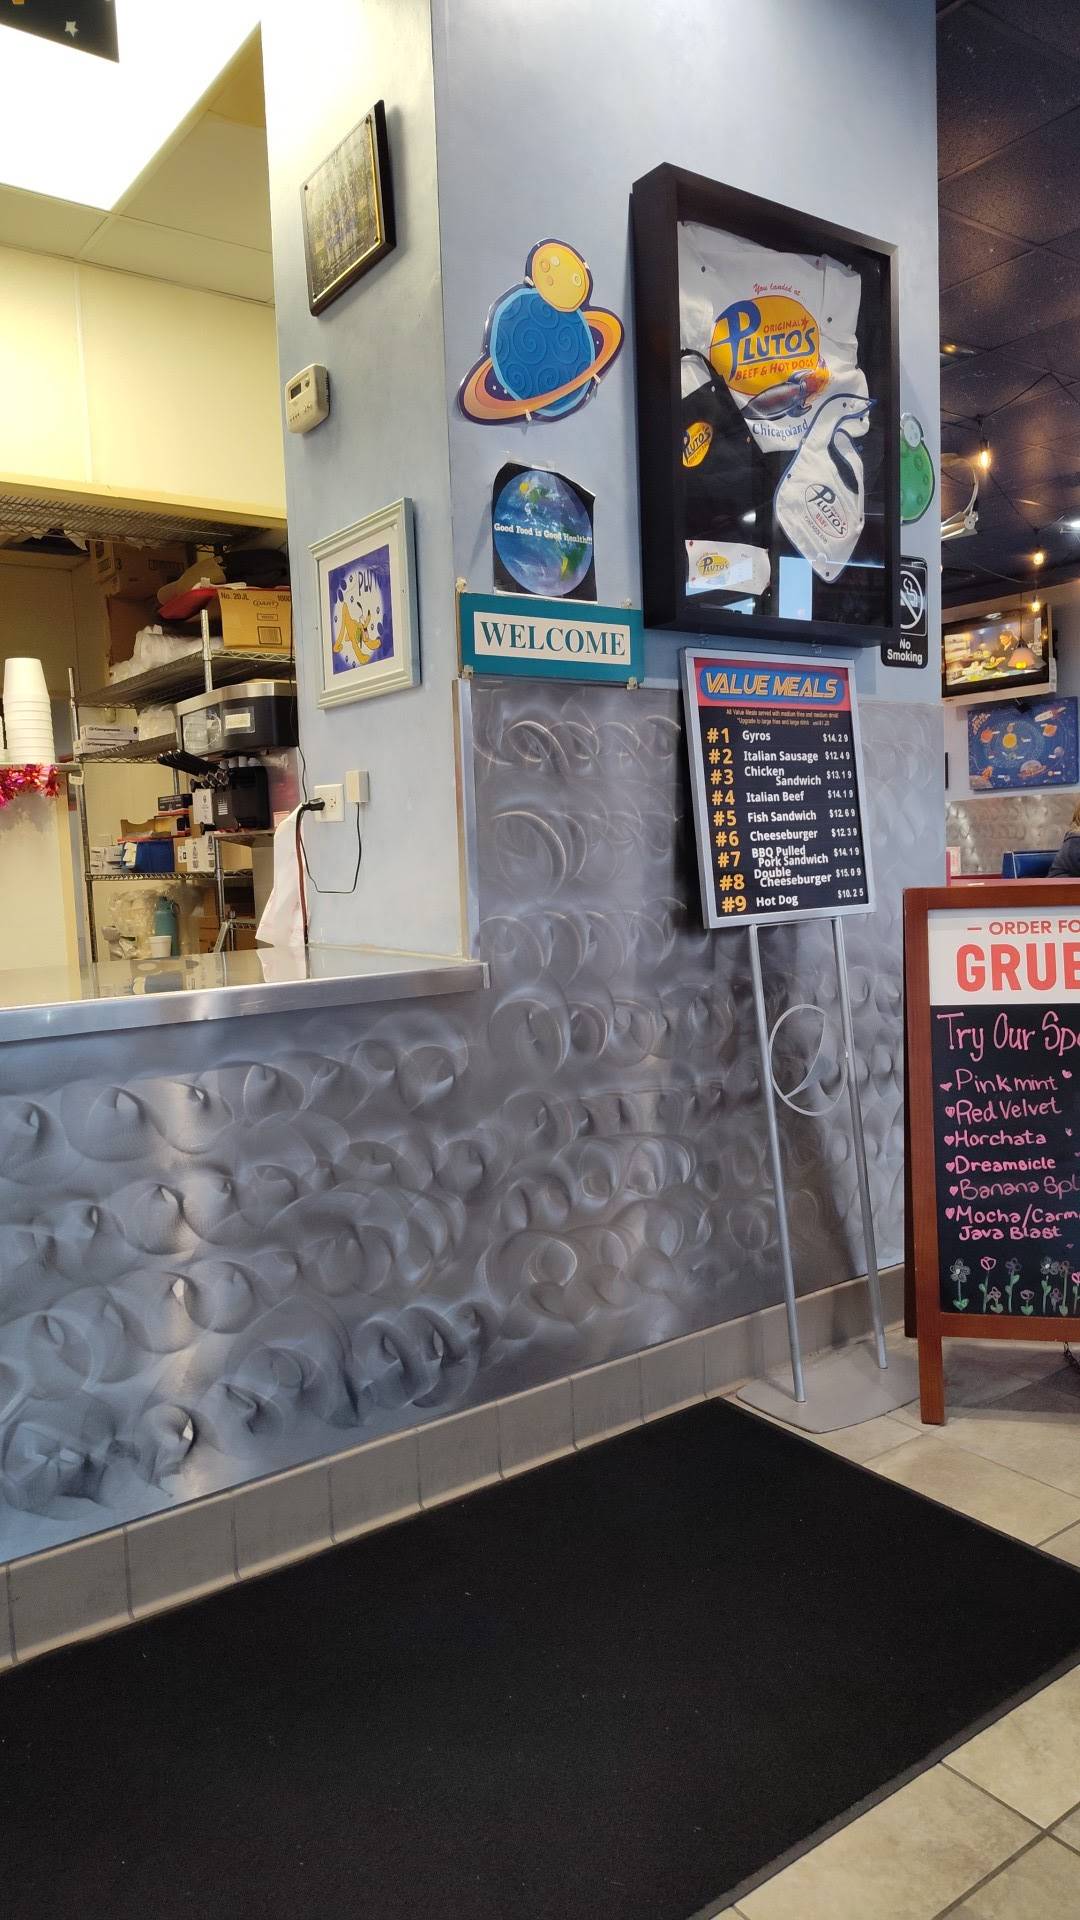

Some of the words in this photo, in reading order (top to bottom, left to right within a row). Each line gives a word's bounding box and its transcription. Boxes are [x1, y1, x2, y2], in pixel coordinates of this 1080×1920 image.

[764, 320, 802, 333] ORIGINAL
[735, 366, 760, 381] BEEF
[760, 366, 769, 376] &
[770, 363, 790, 374] HOT
[791, 358, 814, 370] DOGS
[752, 420, 810, 440] Chicagoland
[494, 523, 514, 533] Good
[535, 528, 542, 537] is
[543, 529, 562, 541] Good
[480, 621, 626, 657] WELCOME
[900, 638, 911, 650] No
[887, 648, 923, 666] Smoking
[706, 672, 771, 696] VALUE
[773, 675, 838, 699] MEALS
[707, 727, 730, 744] #1
[742, 730, 771, 743] Gyros
[708, 748, 734, 765] #2
[744, 751, 777, 761] Italian
[779, 750, 819, 764] Sausage
[710, 768, 734, 785] #3
[744, 766, 785, 777] Chicken
[775, 775, 821, 786] Sandwich
[712, 789, 735, 806] #4
[746, 792, 780, 803] Italian
[782, 790, 805, 801] Beef
[713, 809, 737, 826] #5
[747, 812, 768, 823] Fish
[771, 810, 817, 822] Sandwich
[715, 830, 739, 847] #6
[750, 829, 818, 842] Cheeseburger
[718, 851, 741, 868] #7
[751, 847, 774, 859] BBQ
[776, 845, 806, 857] Pulled
[758, 856, 782, 868] Pork
[784, 853, 829, 866] Sandwich
[719, 873, 745, 891] #8
[754, 867, 792, 879] Double
[760, 873, 832, 888] Cheeseburger
[721, 895, 747, 913] #9
[756, 896, 776, 907] Hot
[779, 895, 799, 907] Dog
[989, 920, 1052, 935] ORDER
[937, 1011, 984, 1062] Try
[993, 1012, 1036, 1051] Our
[1042, 1010, 1080, 1057] Sp
[956, 1099, 998, 1125] Red
[999, 1096, 1063, 1120] Velvet
[954, 1129, 1047, 1148] Horchata
[954, 1155, 1057, 1175] Dreamsicle
[959, 1178, 1039, 1200] Banana
[959, 1225, 1005, 1241] Java
[1009, 1225, 1062, 1240] Blast
